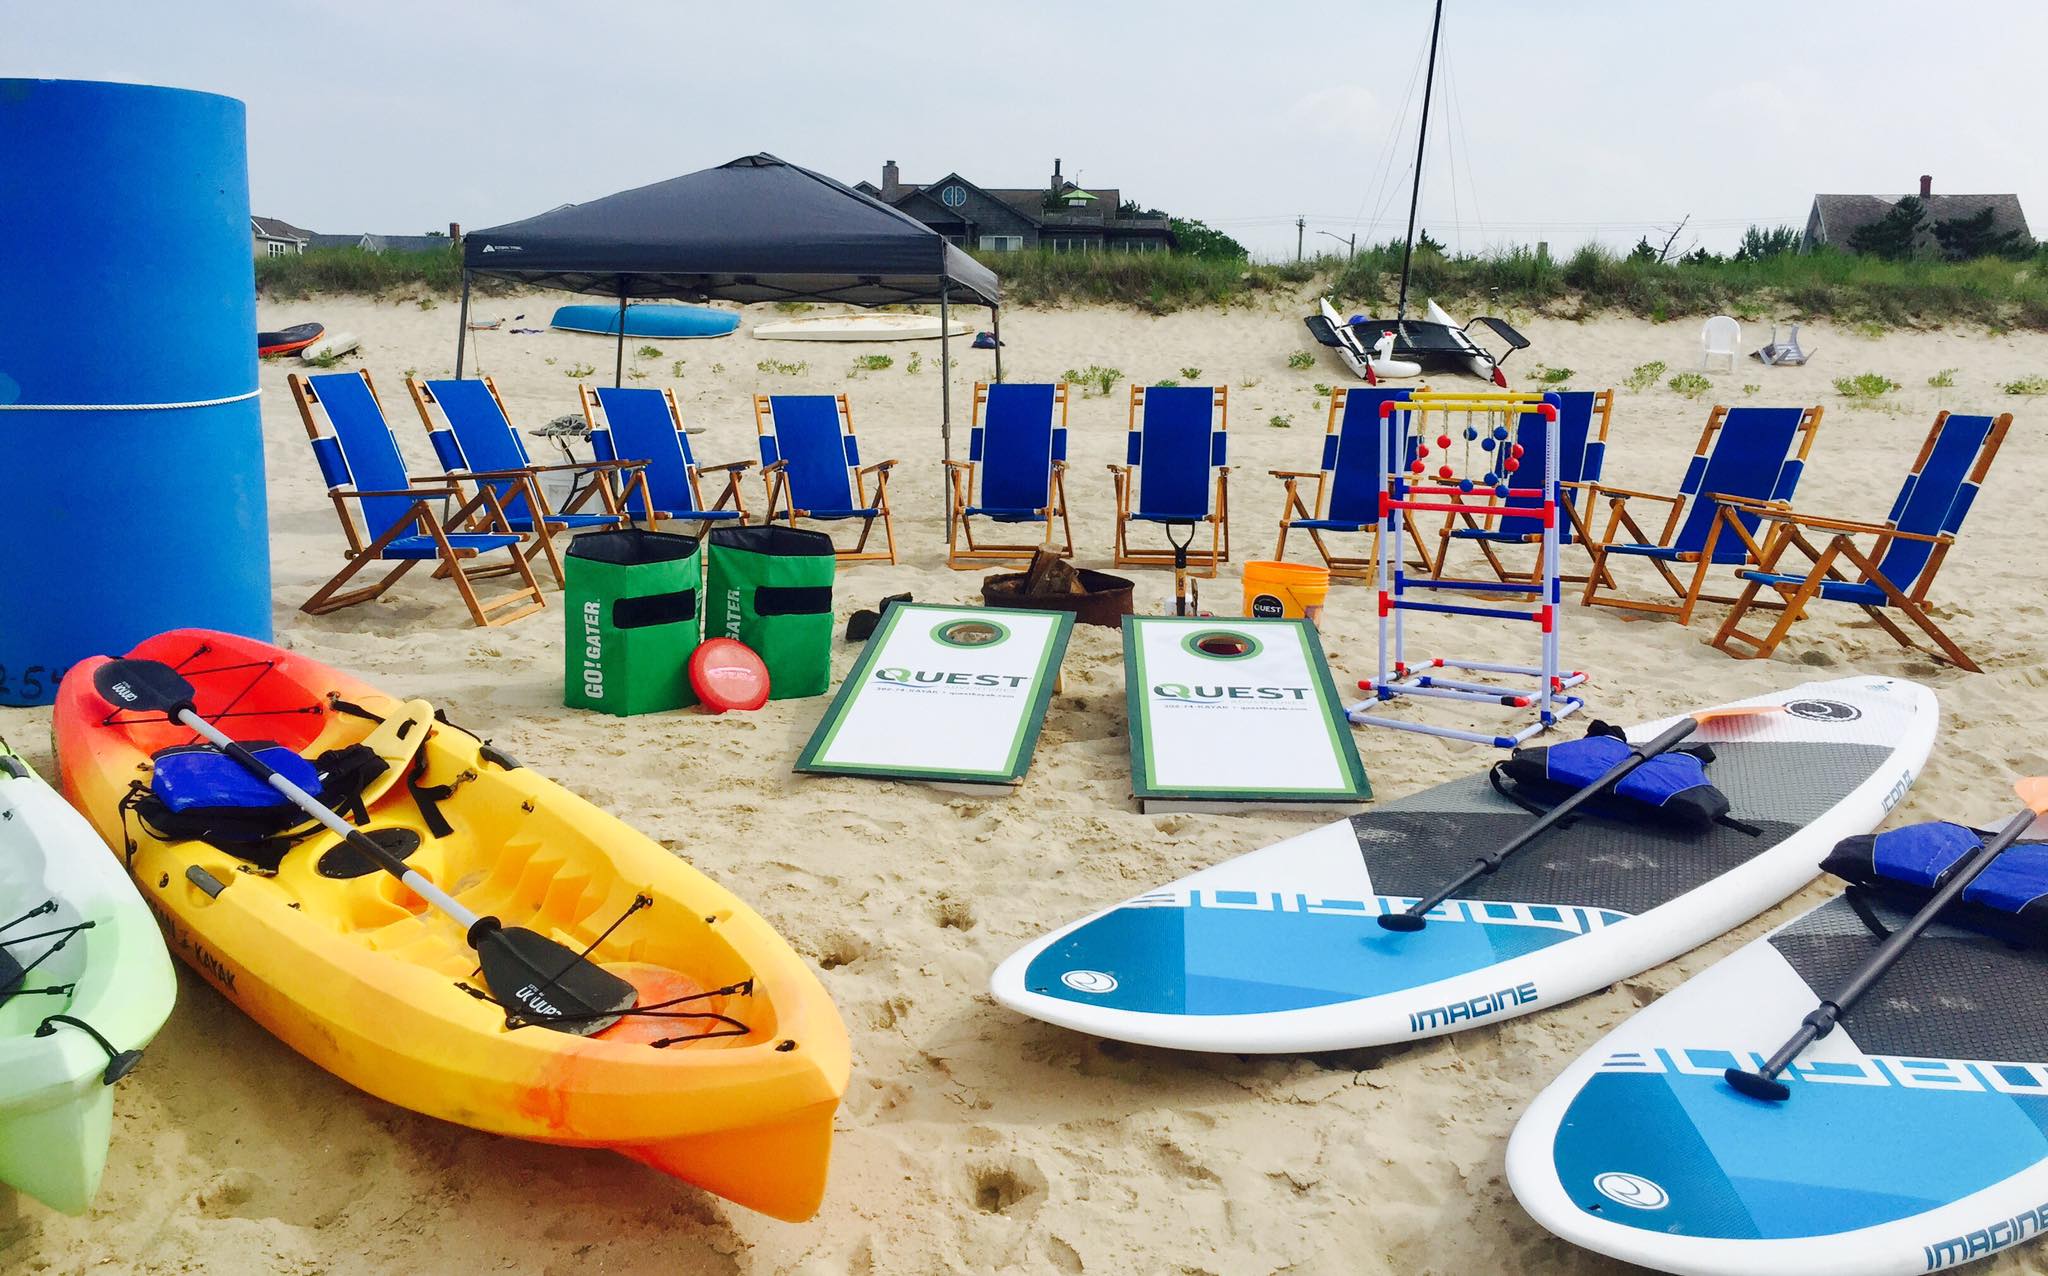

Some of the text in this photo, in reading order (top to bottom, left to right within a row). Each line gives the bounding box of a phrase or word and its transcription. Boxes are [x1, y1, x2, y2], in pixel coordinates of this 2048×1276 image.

[1254, 603, 1281, 613] QUEST
[583, 660, 603, 698] GO!
[875, 667, 1028, 688] QUEST
[1153, 683, 1309, 700] QUEST
[1409, 981, 1538, 1032] IMAGINE
[1923, 1202, 2048, 1271] IMAGINE
